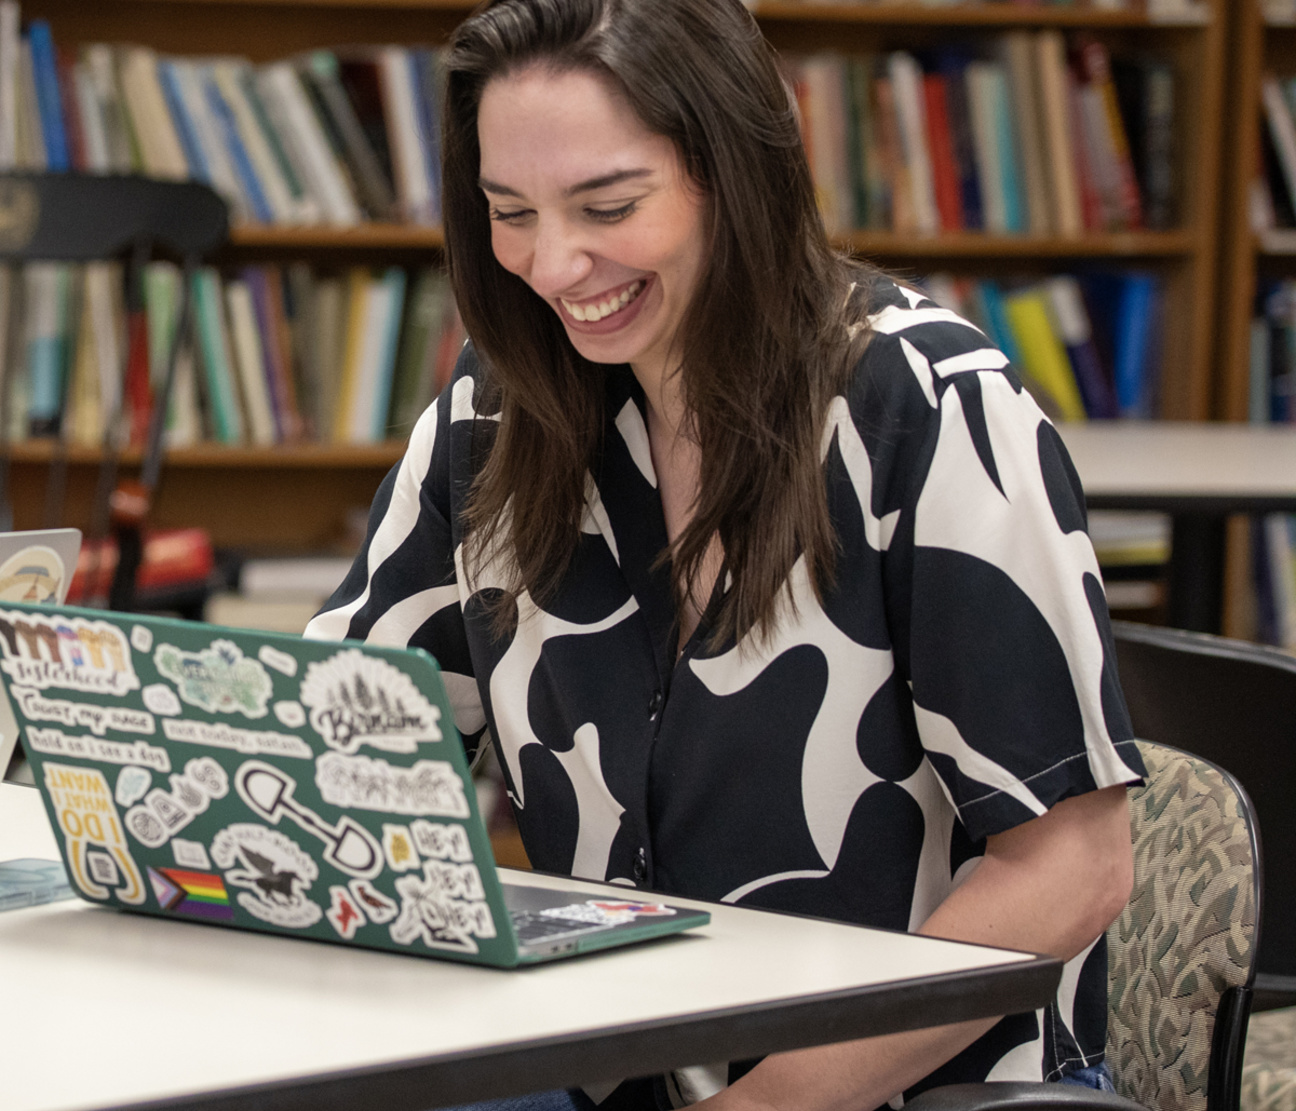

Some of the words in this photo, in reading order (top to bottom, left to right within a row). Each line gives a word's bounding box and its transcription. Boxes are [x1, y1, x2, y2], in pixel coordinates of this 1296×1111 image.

[48, 767, 107, 797] WANT
[62, 809, 106, 841] DO
[108, 816, 122, 844] I
